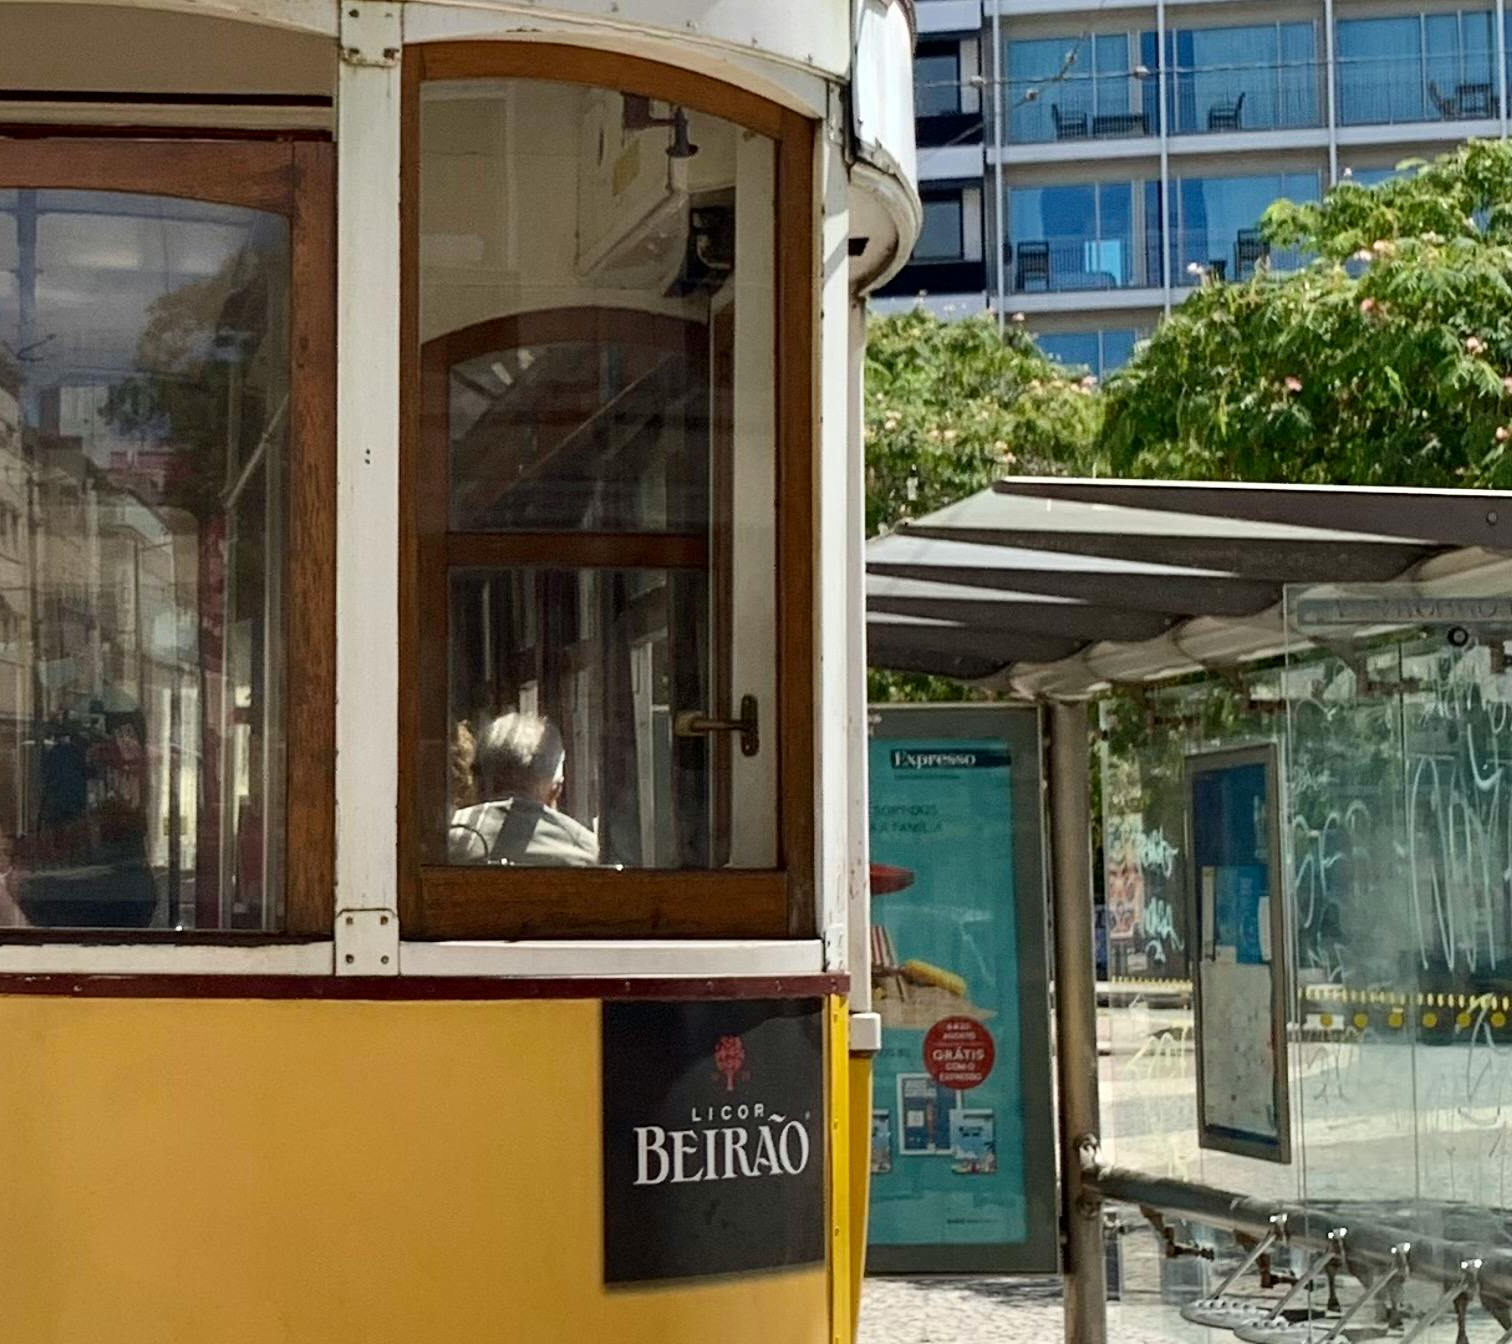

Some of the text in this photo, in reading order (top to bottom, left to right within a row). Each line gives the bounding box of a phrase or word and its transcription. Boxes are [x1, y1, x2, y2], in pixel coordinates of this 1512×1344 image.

[894, 750, 977, 770] Expresso
[932, 1045, 985, 1061] GRÁTIS
[692, 1103, 765, 1122] LICOR
[633, 1113, 810, 1186] BEIRÃO
